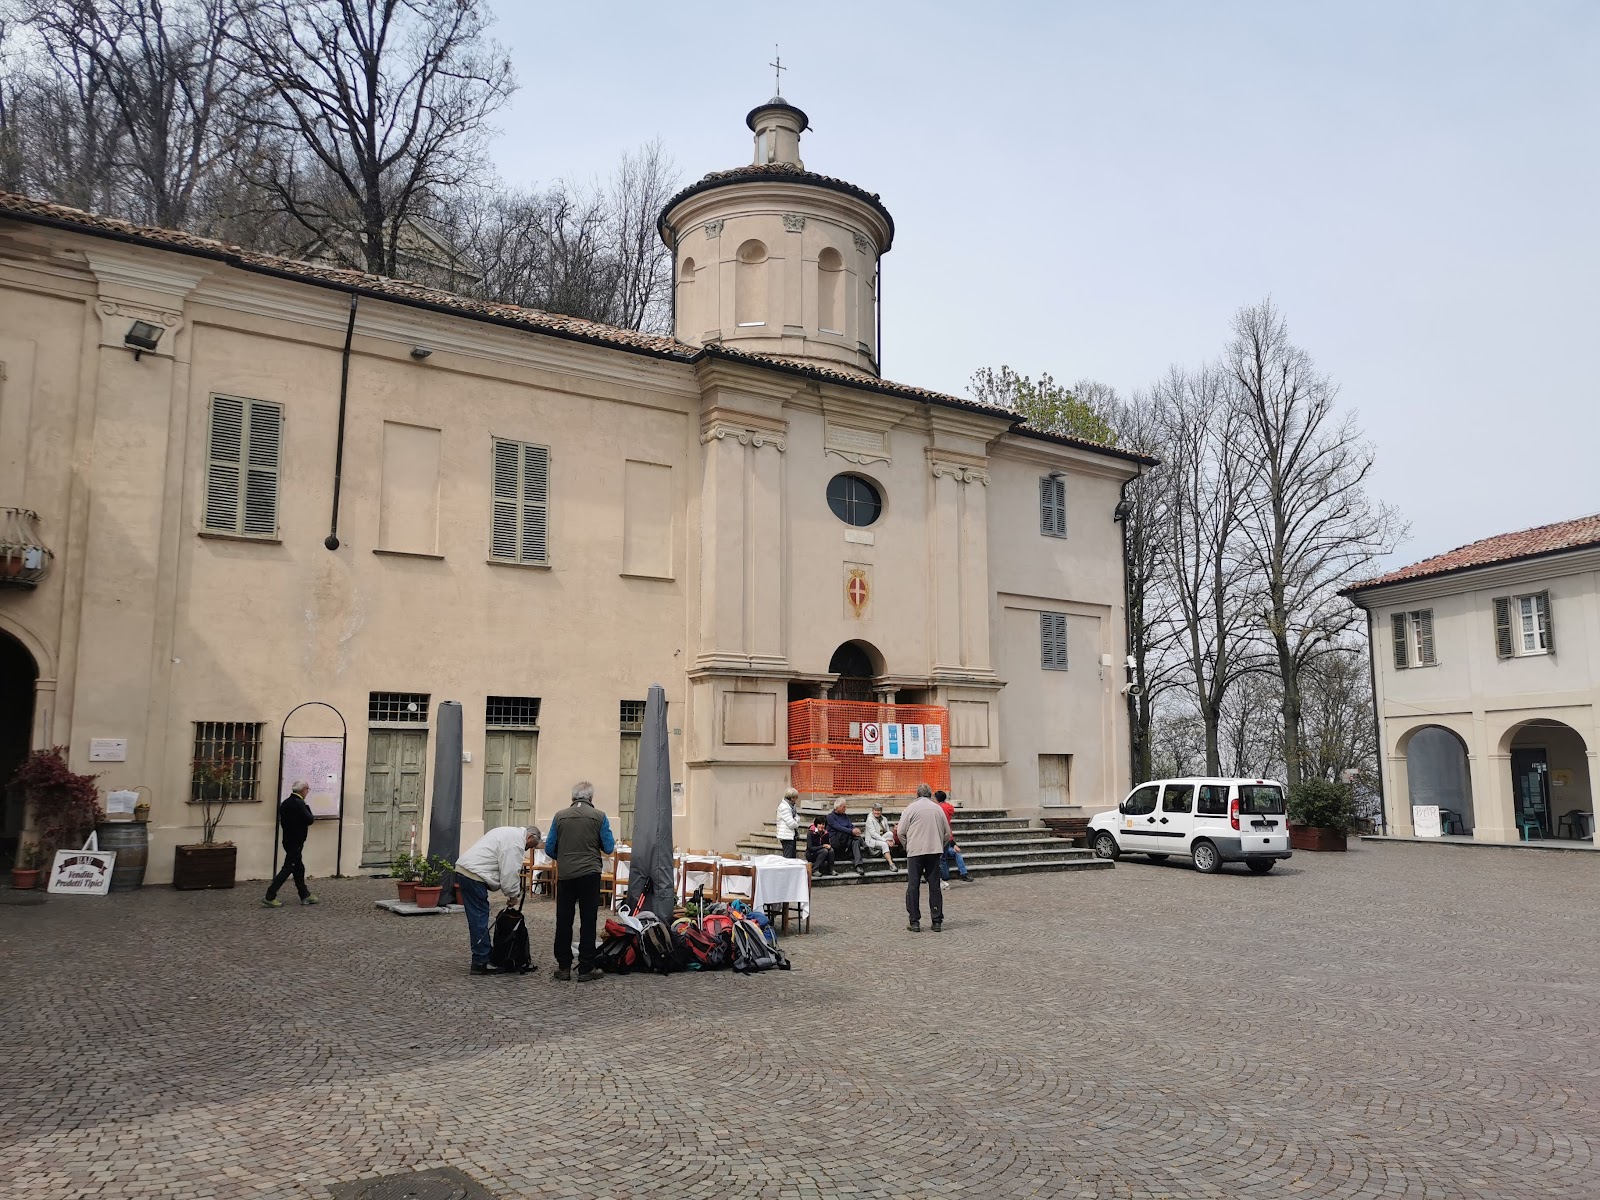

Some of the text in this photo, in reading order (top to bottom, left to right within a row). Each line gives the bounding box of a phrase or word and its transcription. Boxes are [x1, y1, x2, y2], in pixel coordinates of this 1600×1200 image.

[1415, 807, 1437, 818] BAR
[68, 870, 94, 878] Vendita
[84, 879, 104, 888] Tipici
